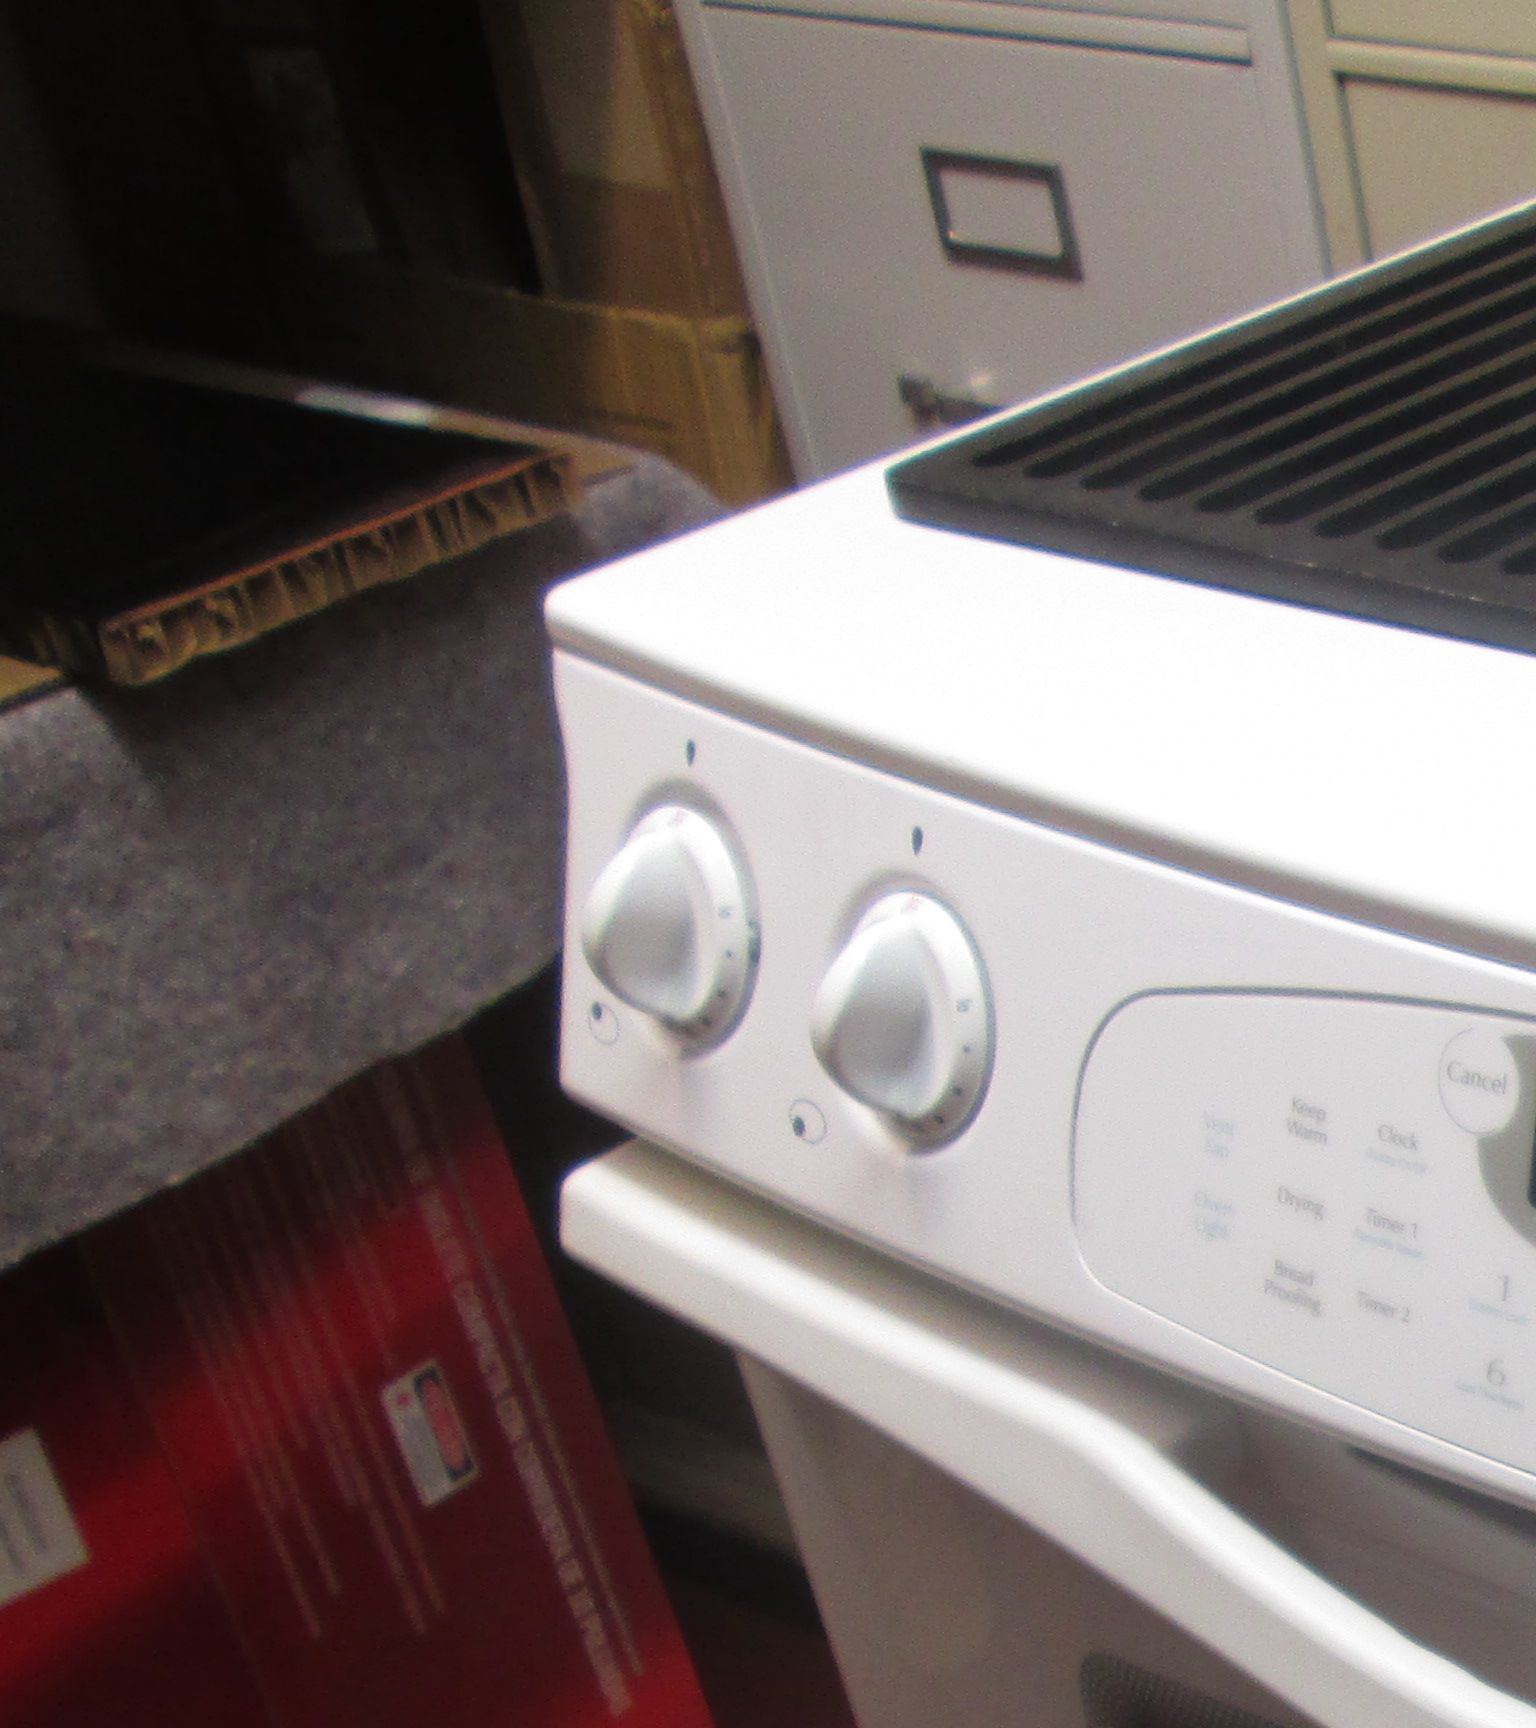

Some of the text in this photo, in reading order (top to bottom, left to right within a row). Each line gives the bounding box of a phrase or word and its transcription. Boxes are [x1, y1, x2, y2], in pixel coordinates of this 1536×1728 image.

[1446, 1060, 1508, 1095] Cancel
[1292, 1097, 1327, 1122] Keep
[1286, 1119, 1328, 1145] Warm
[1377, 1123, 1418, 1151] Clock
[1277, 1185, 1325, 1222] Drying
[1366, 1208, 1419, 1240] Timer 1
[1499, 1274, 1510, 1302] 1
[1357, 1289, 1411, 1324] Timer 2
[1486, 1359, 1506, 1386] 6
